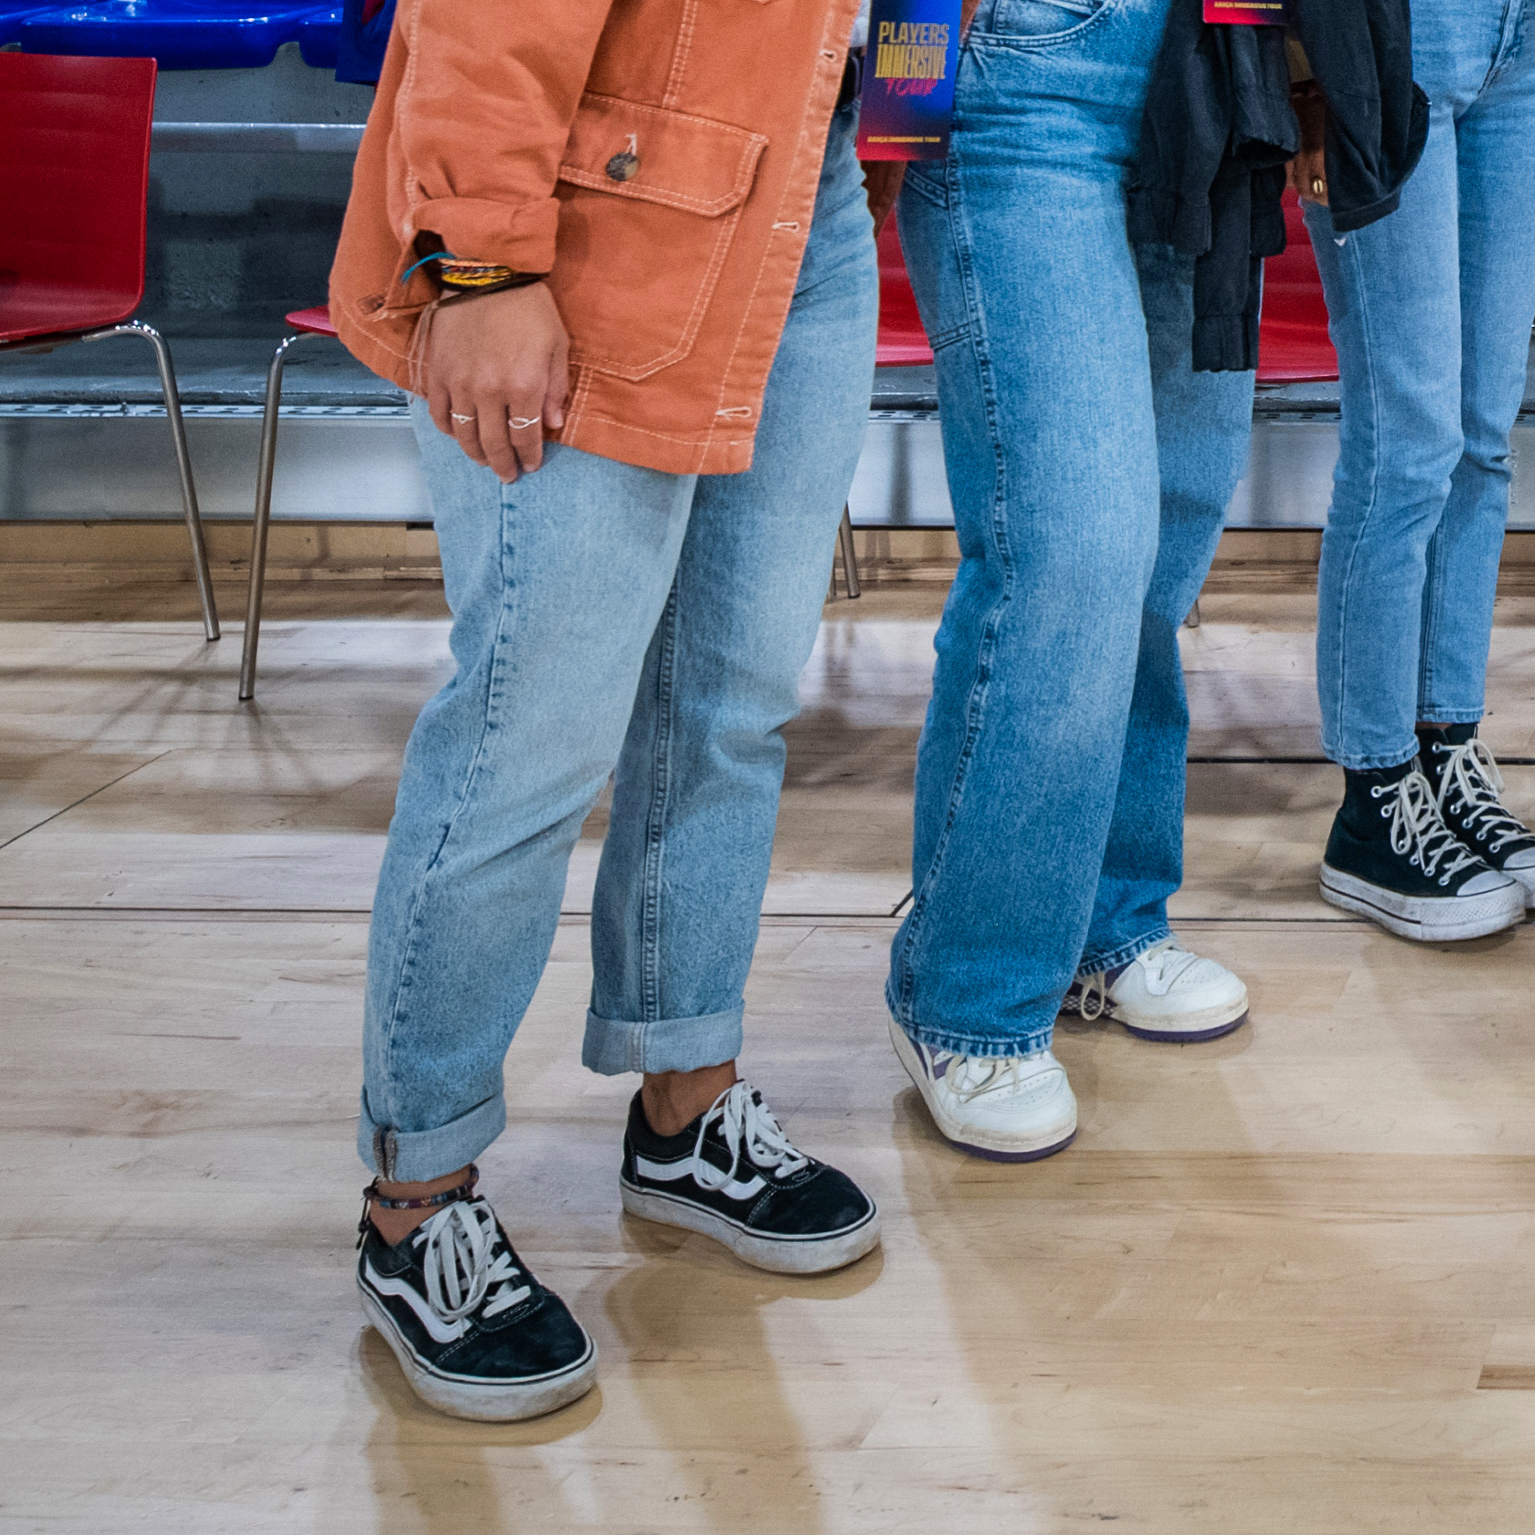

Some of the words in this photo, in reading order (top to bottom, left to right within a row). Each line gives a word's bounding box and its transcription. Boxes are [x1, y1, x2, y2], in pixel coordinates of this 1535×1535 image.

[878, 21, 950, 44] PLAYERS
[874, 43, 948, 79] IMMERSIVE
[885, 77, 938, 97] TOUR
